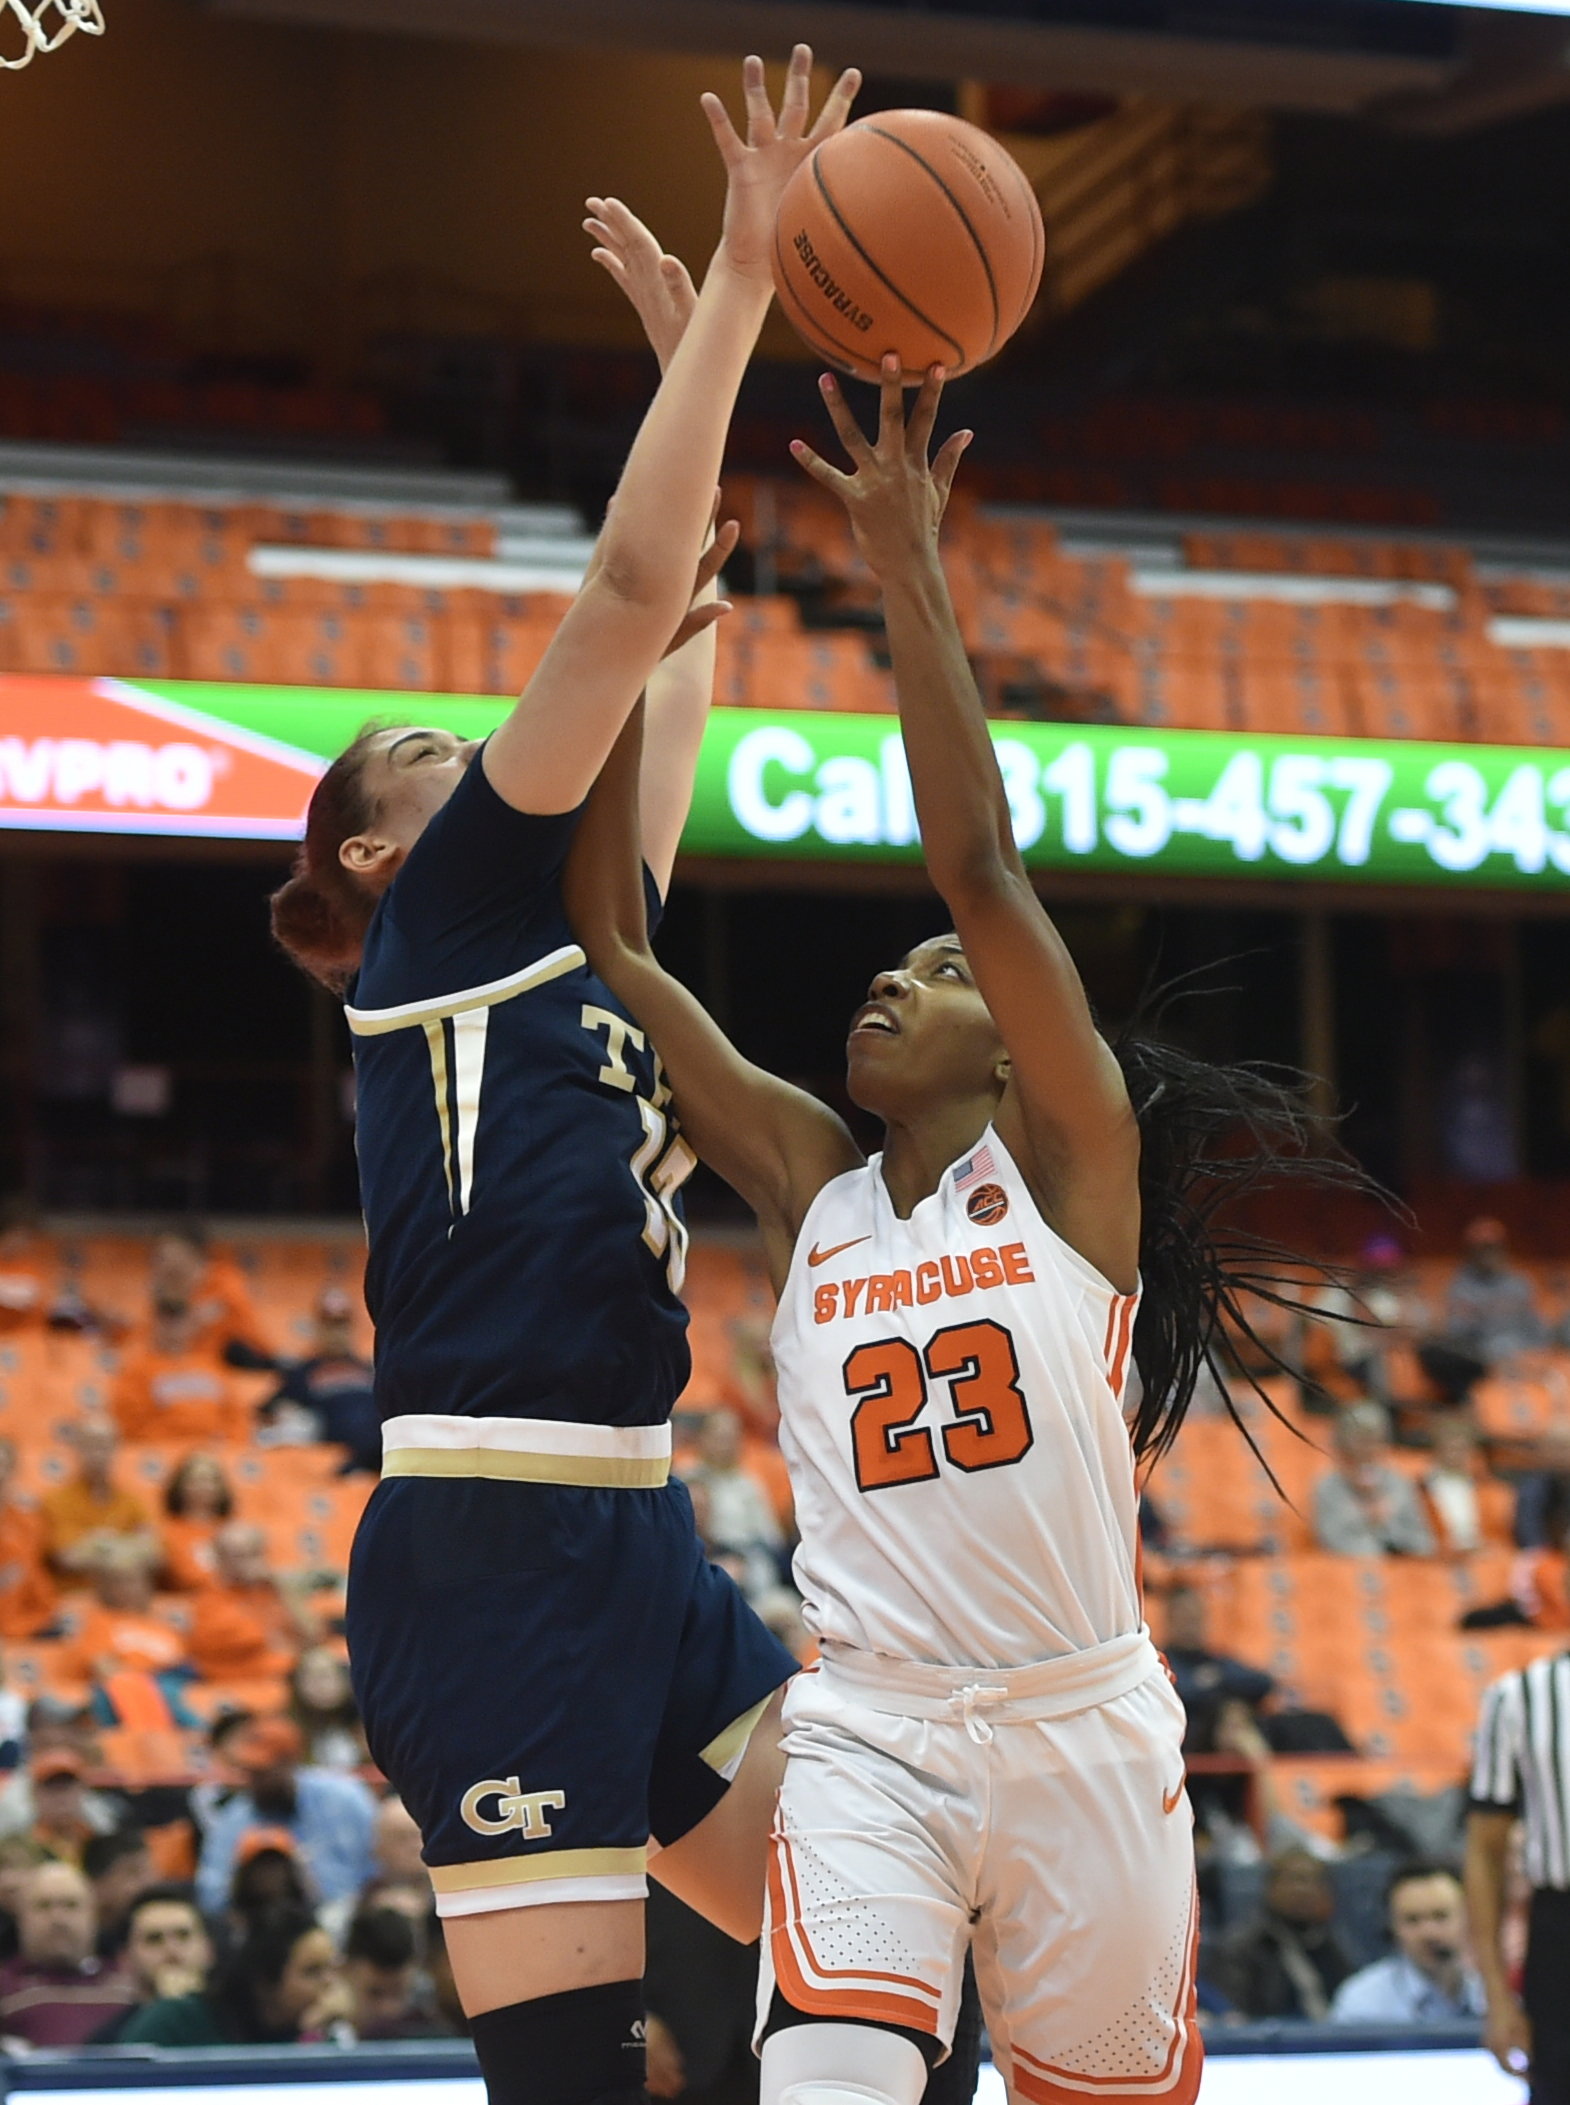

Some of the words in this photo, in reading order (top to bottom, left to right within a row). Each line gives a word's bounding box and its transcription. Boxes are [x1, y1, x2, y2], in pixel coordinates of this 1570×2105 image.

[794, 229, 873, 332] SYRACUSE
[0, 737, 212, 808] VPRO
[814, 1242, 1036, 1325] SYRACUSE
[842, 1318, 1034, 1492] 23
[460, 1776, 566, 1840] GT
